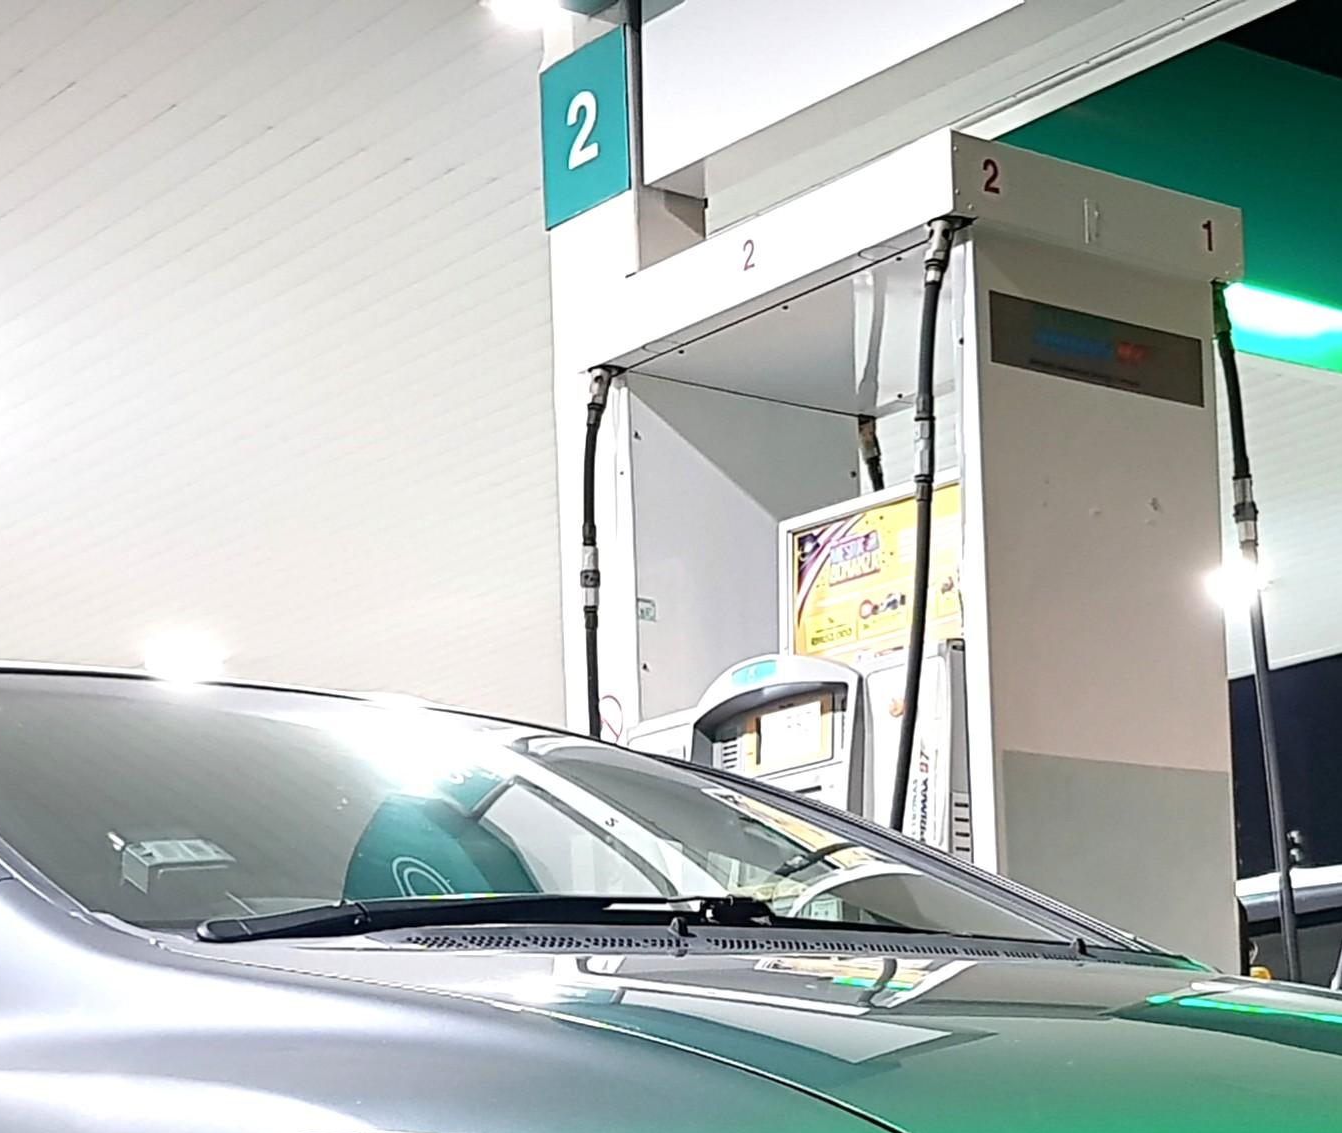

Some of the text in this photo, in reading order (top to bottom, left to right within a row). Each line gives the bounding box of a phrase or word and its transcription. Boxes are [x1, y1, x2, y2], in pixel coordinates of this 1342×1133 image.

[566, 90, 600, 170] 2
[983, 158, 1001, 195] 2
[1201, 219, 1214, 252] 1
[742, 238, 756, 272] 2
